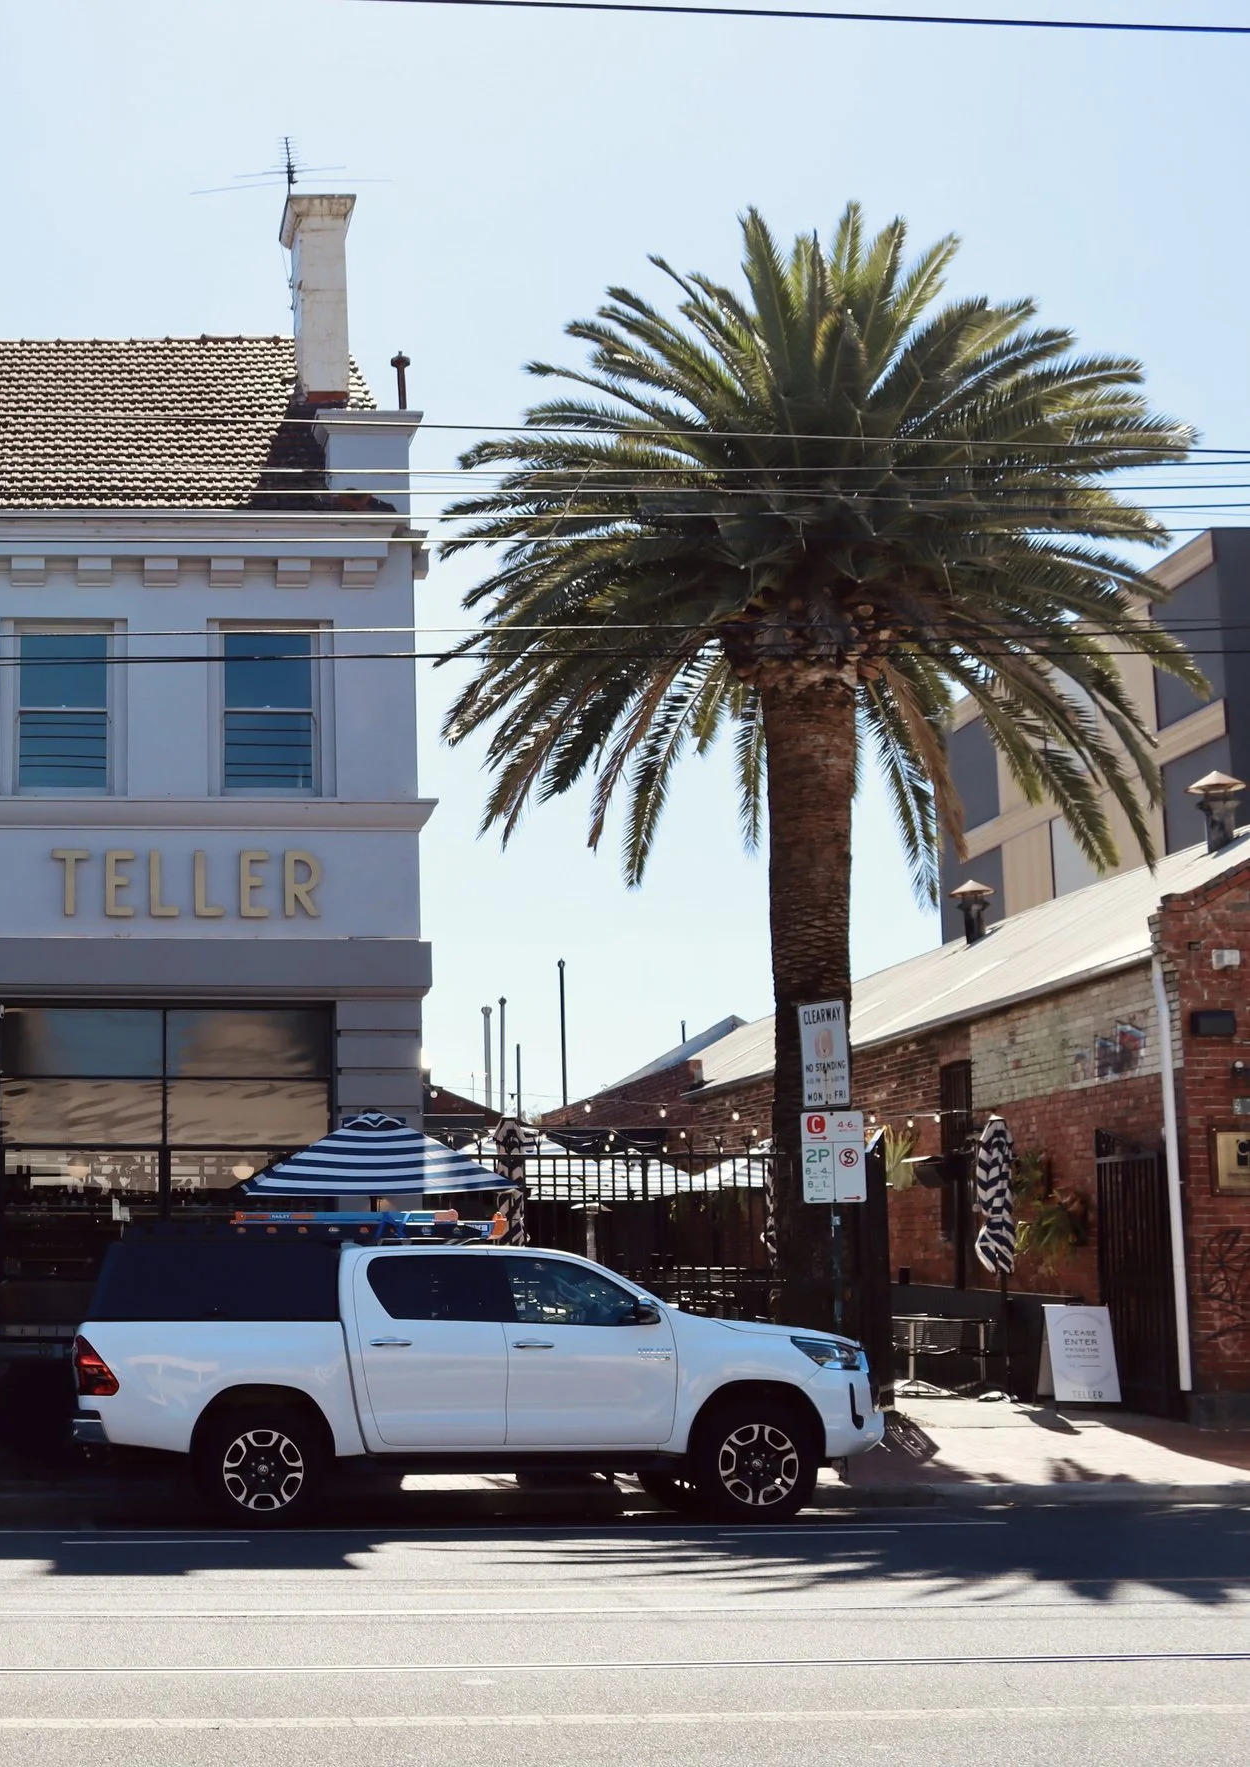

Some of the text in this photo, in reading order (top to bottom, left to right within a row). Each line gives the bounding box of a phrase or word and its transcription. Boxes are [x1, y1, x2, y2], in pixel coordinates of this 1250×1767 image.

[51, 848, 322, 918] TELLER
[803, 1006, 841, 1025] CLEARWAY
[805, 1060, 846, 1073] NO STANDING
[807, 1092, 823, 1102] MON
[834, 1090, 846, 1100] FRI
[805, 1148, 830, 1163] 2P
[1062, 1329, 1097, 1337] PLEASE
[1064, 1338, 1098, 1346] ENTER
[1071, 1389, 1104, 1400] TELLER
